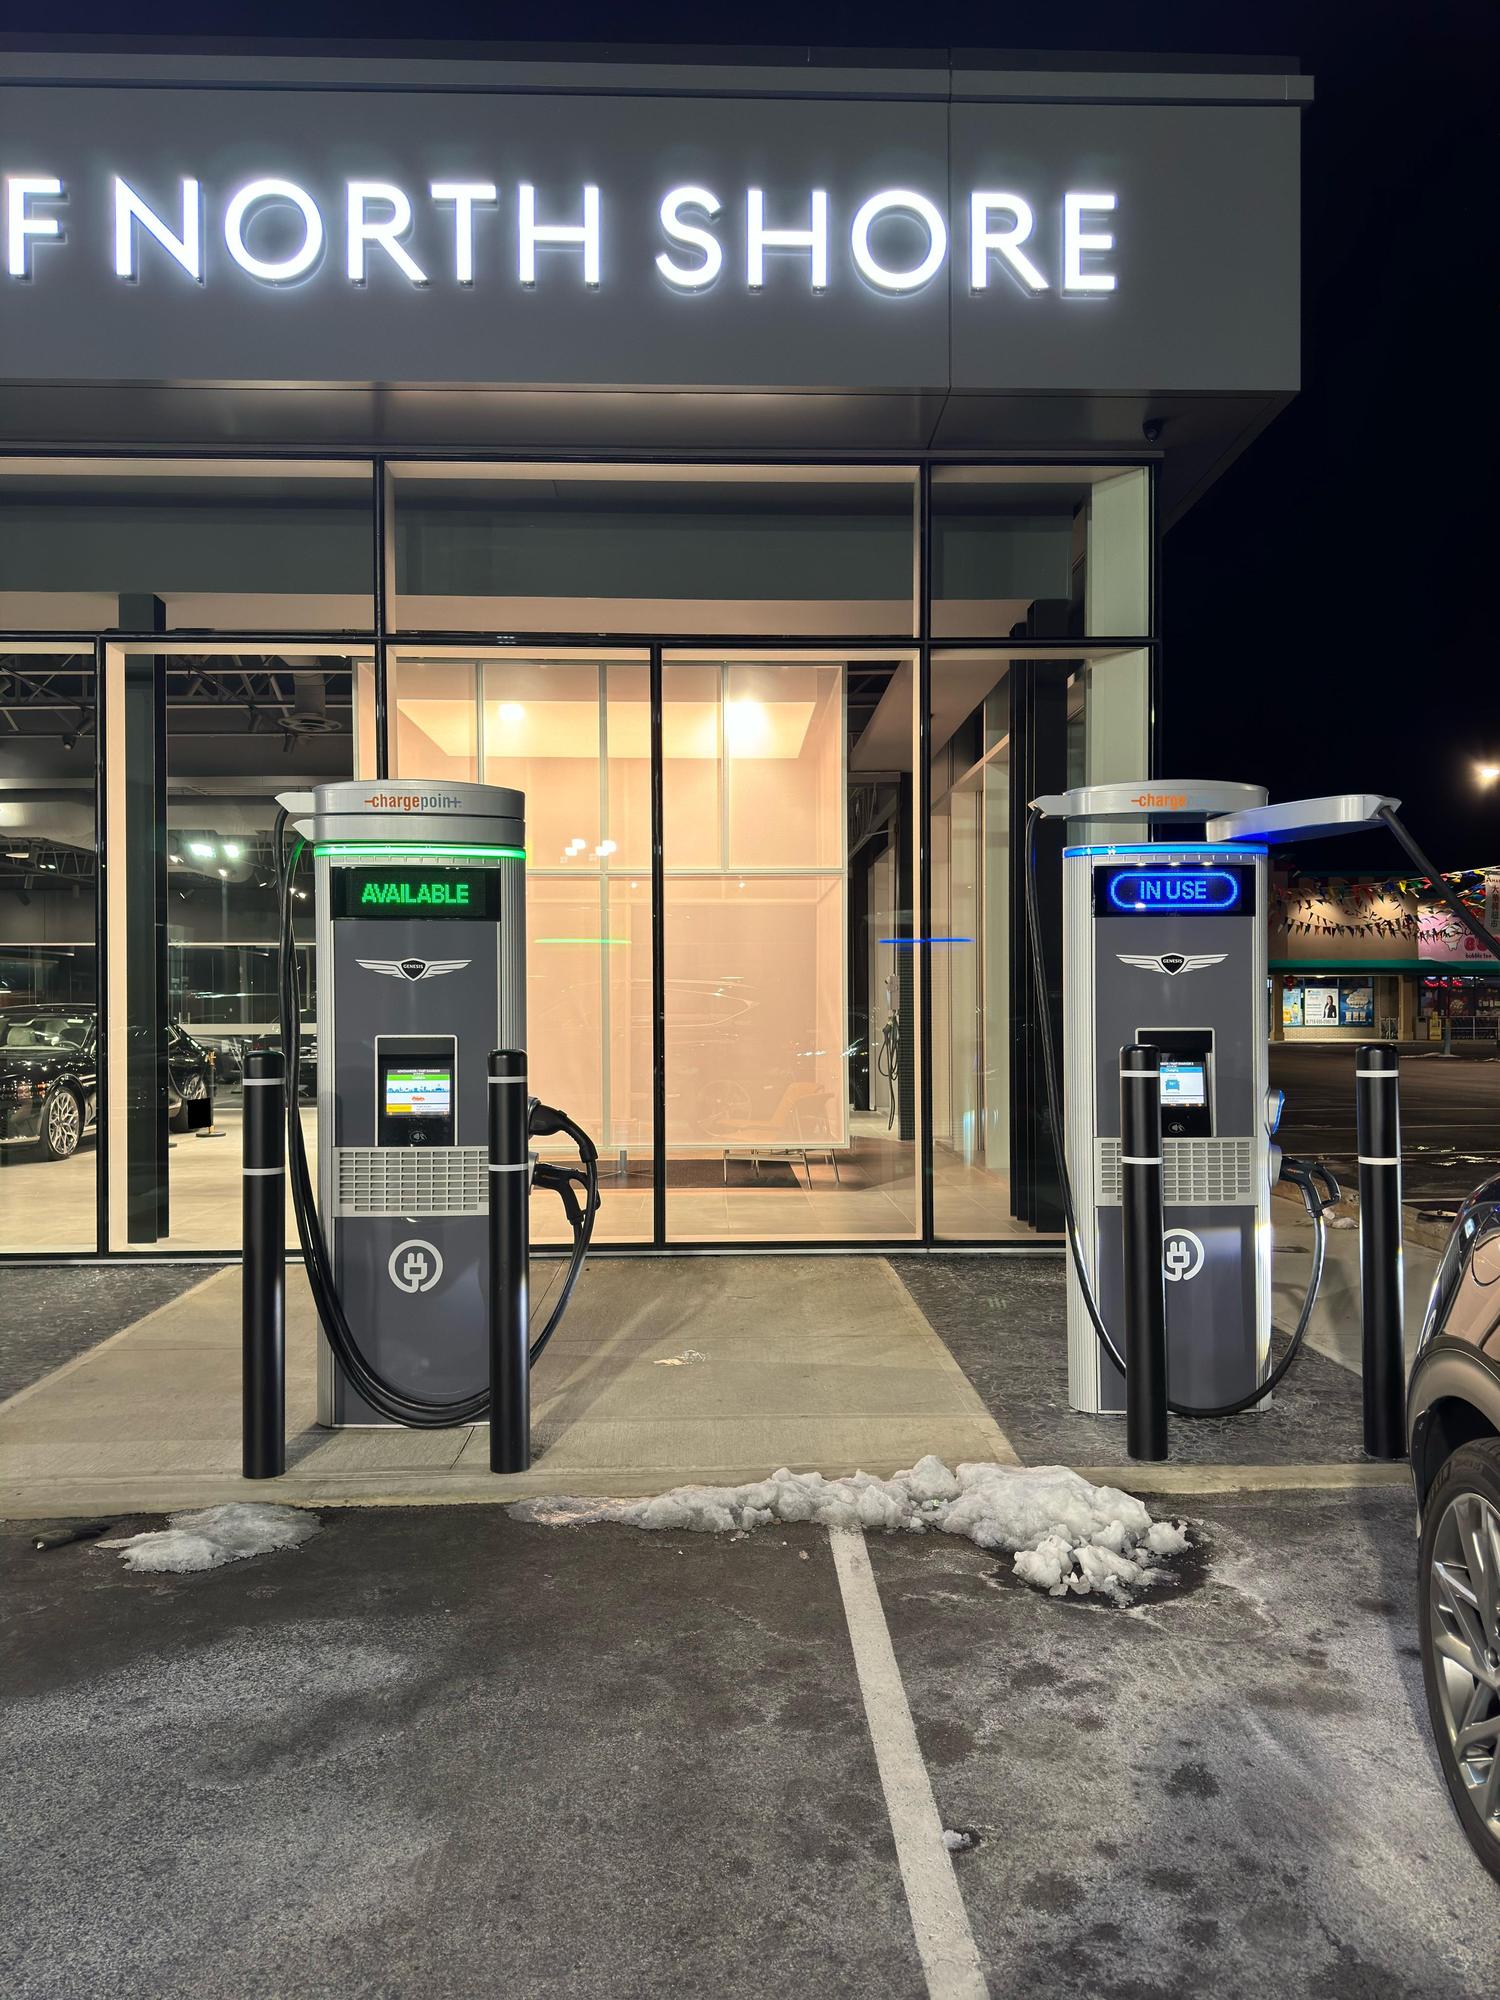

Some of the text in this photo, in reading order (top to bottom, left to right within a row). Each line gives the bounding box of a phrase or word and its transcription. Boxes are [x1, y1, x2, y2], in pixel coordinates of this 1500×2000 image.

[113, 175, 600, 286] NORTH
[655, 186, 1117, 295] SHORE
[365, 794, 462, 811] chargepoint
[361, 883, 469, 903] AVAILABLE
[1140, 880, 1207, 899] IN USE
